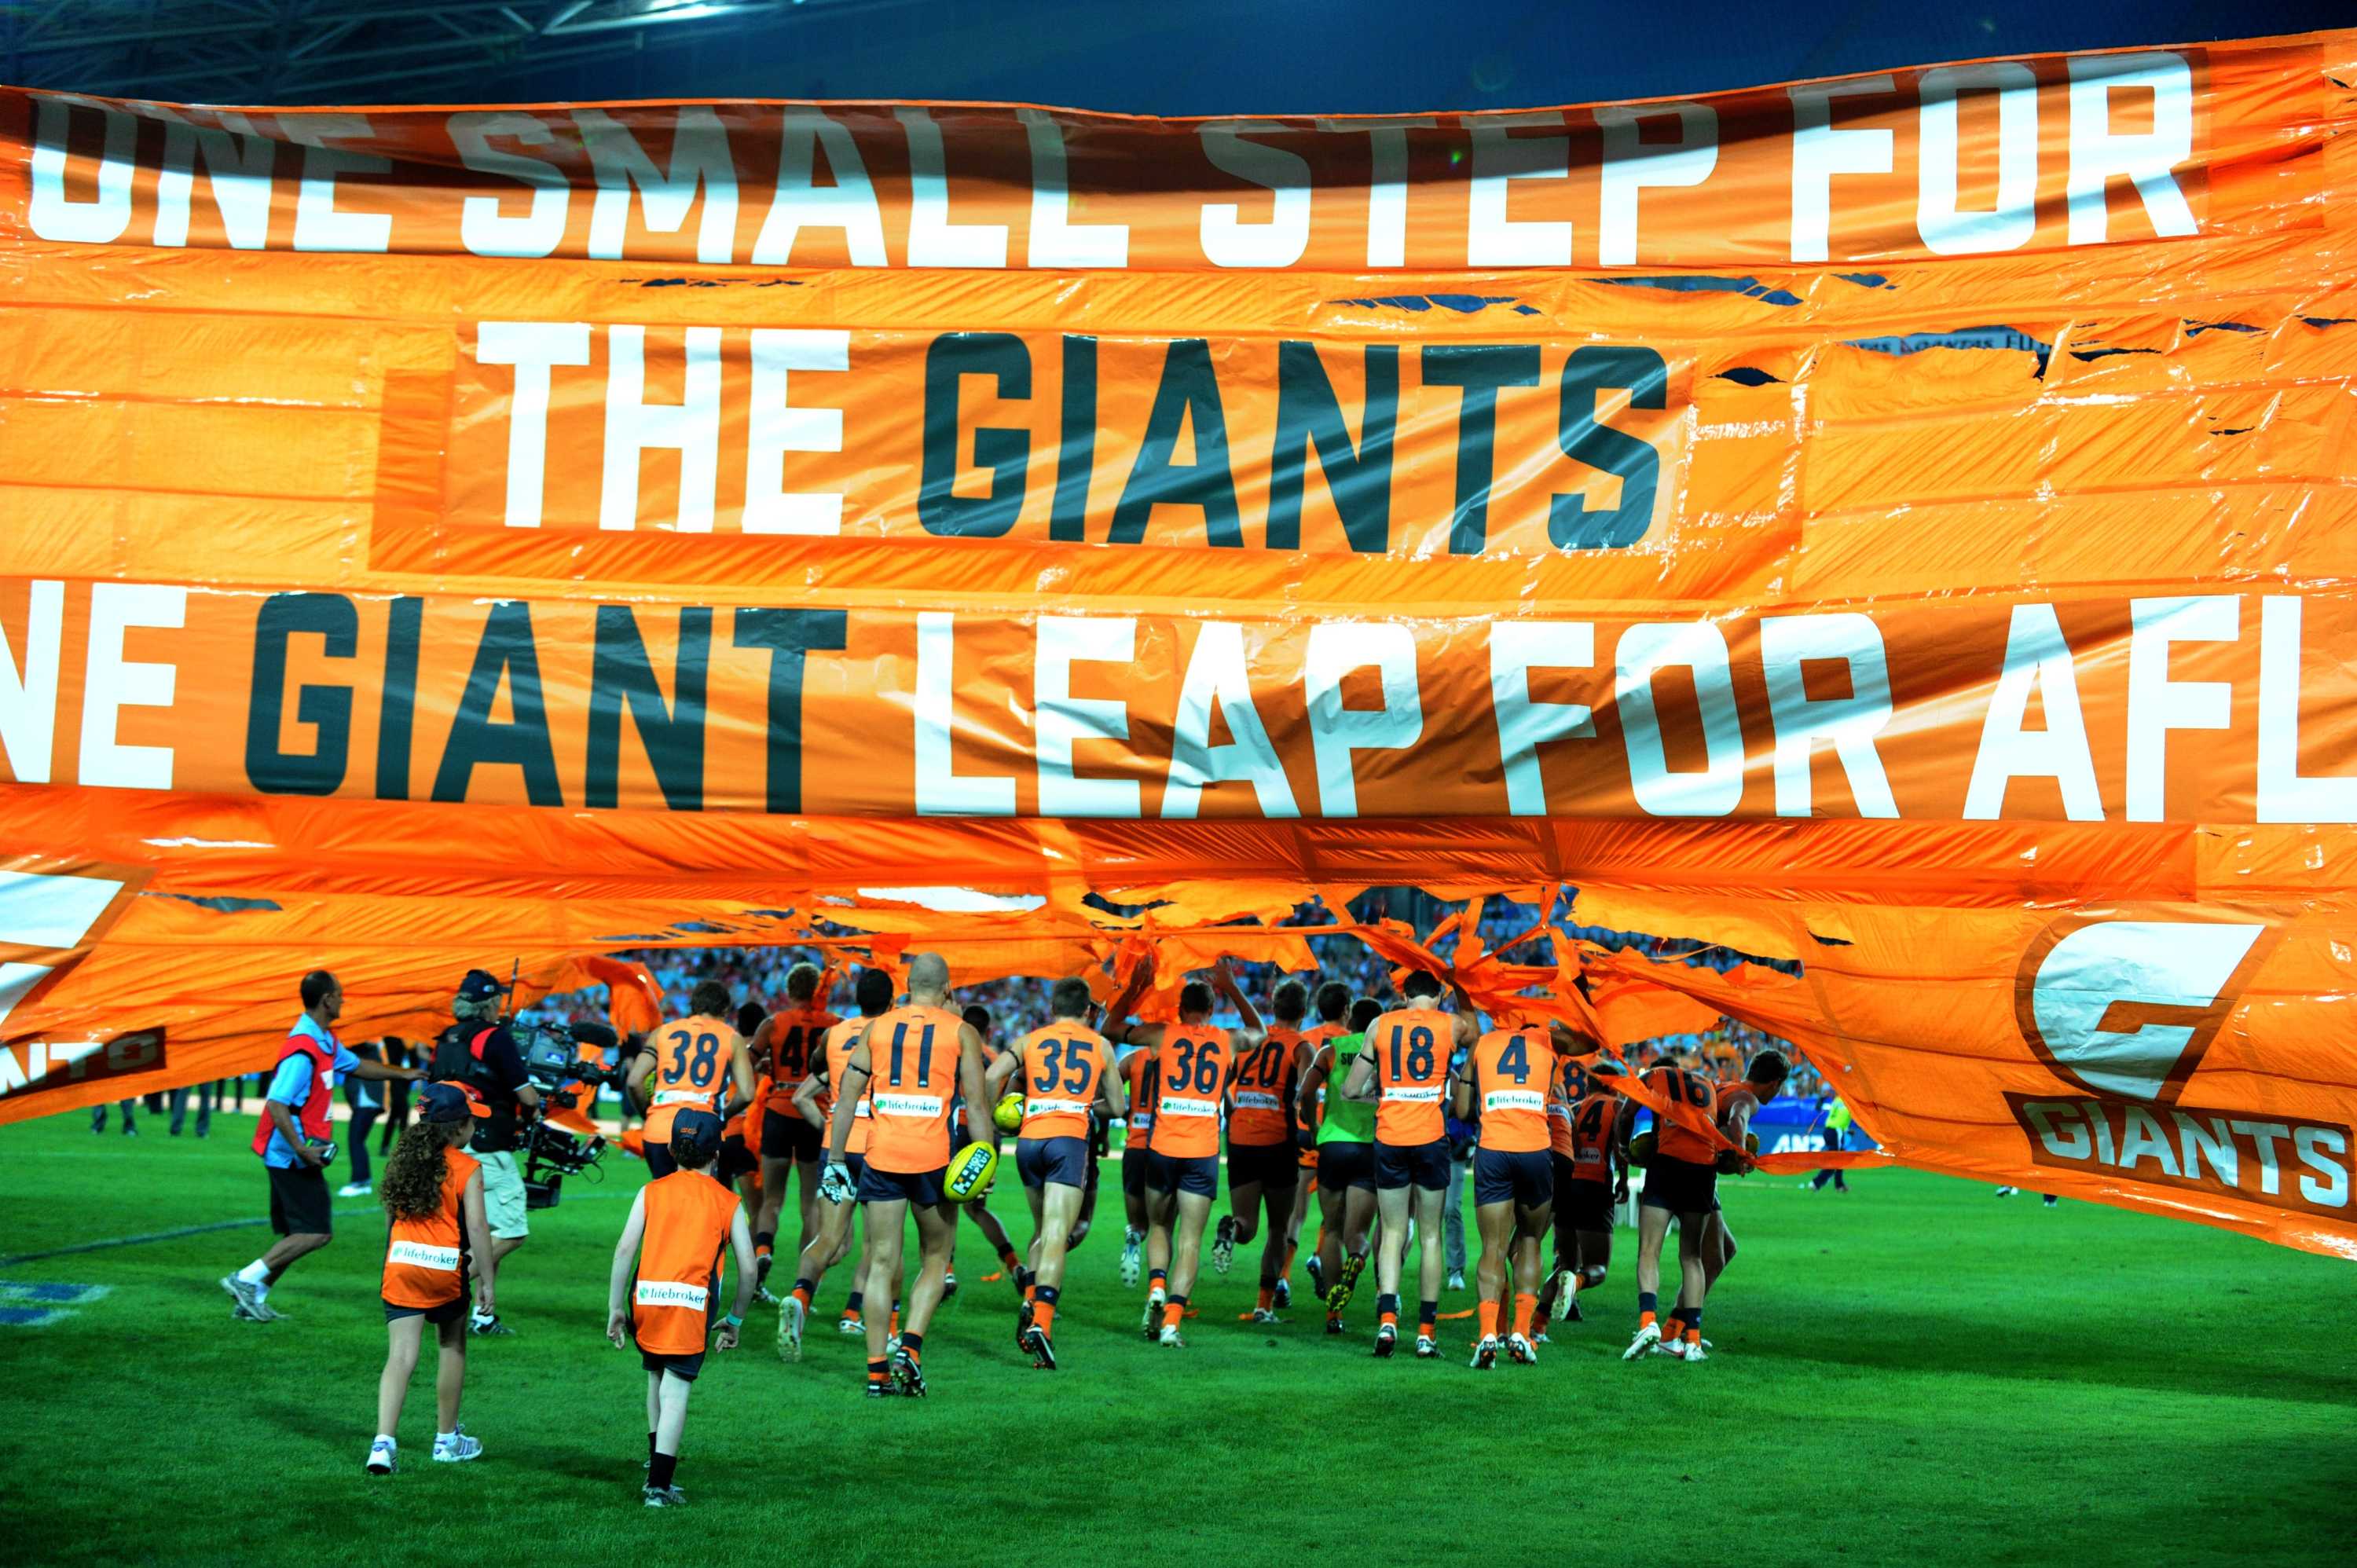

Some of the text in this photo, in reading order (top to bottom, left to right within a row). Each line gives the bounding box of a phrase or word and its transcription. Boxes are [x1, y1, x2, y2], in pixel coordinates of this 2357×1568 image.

[27, 51, 2199, 268] ONE SMALL STEP FOR
[476, 321, 1668, 555] THE GIANTS
[245, 592, 849, 815] GIANT
[914, 612, 1424, 820] LEAP
[1490, 612, 1901, 819] FOR
[1962, 595, 2357, 823] AFL
[663, 1030, 719, 1087] 38
[889, 1022, 935, 1088] 11
[1033, 1039, 1093, 1095] 35
[1168, 1038, 1221, 1094] 36
[1237, 1042, 1285, 1087] 20
[1340, 1052, 1358, 1066] SU
[1391, 1025, 1434, 1081] 18
[1497, 1035, 1530, 1084] 4
[888, 1099, 940, 1113] lifebroker
[1497, 1095, 1542, 1106] lifebroker
[1771, 1133, 1826, 1154] ANZ
[2023, 1101, 2349, 1208] GIANTS
[403, 1246, 457, 1265] lifebroker
[650, 1288, 705, 1305] lifebroker
